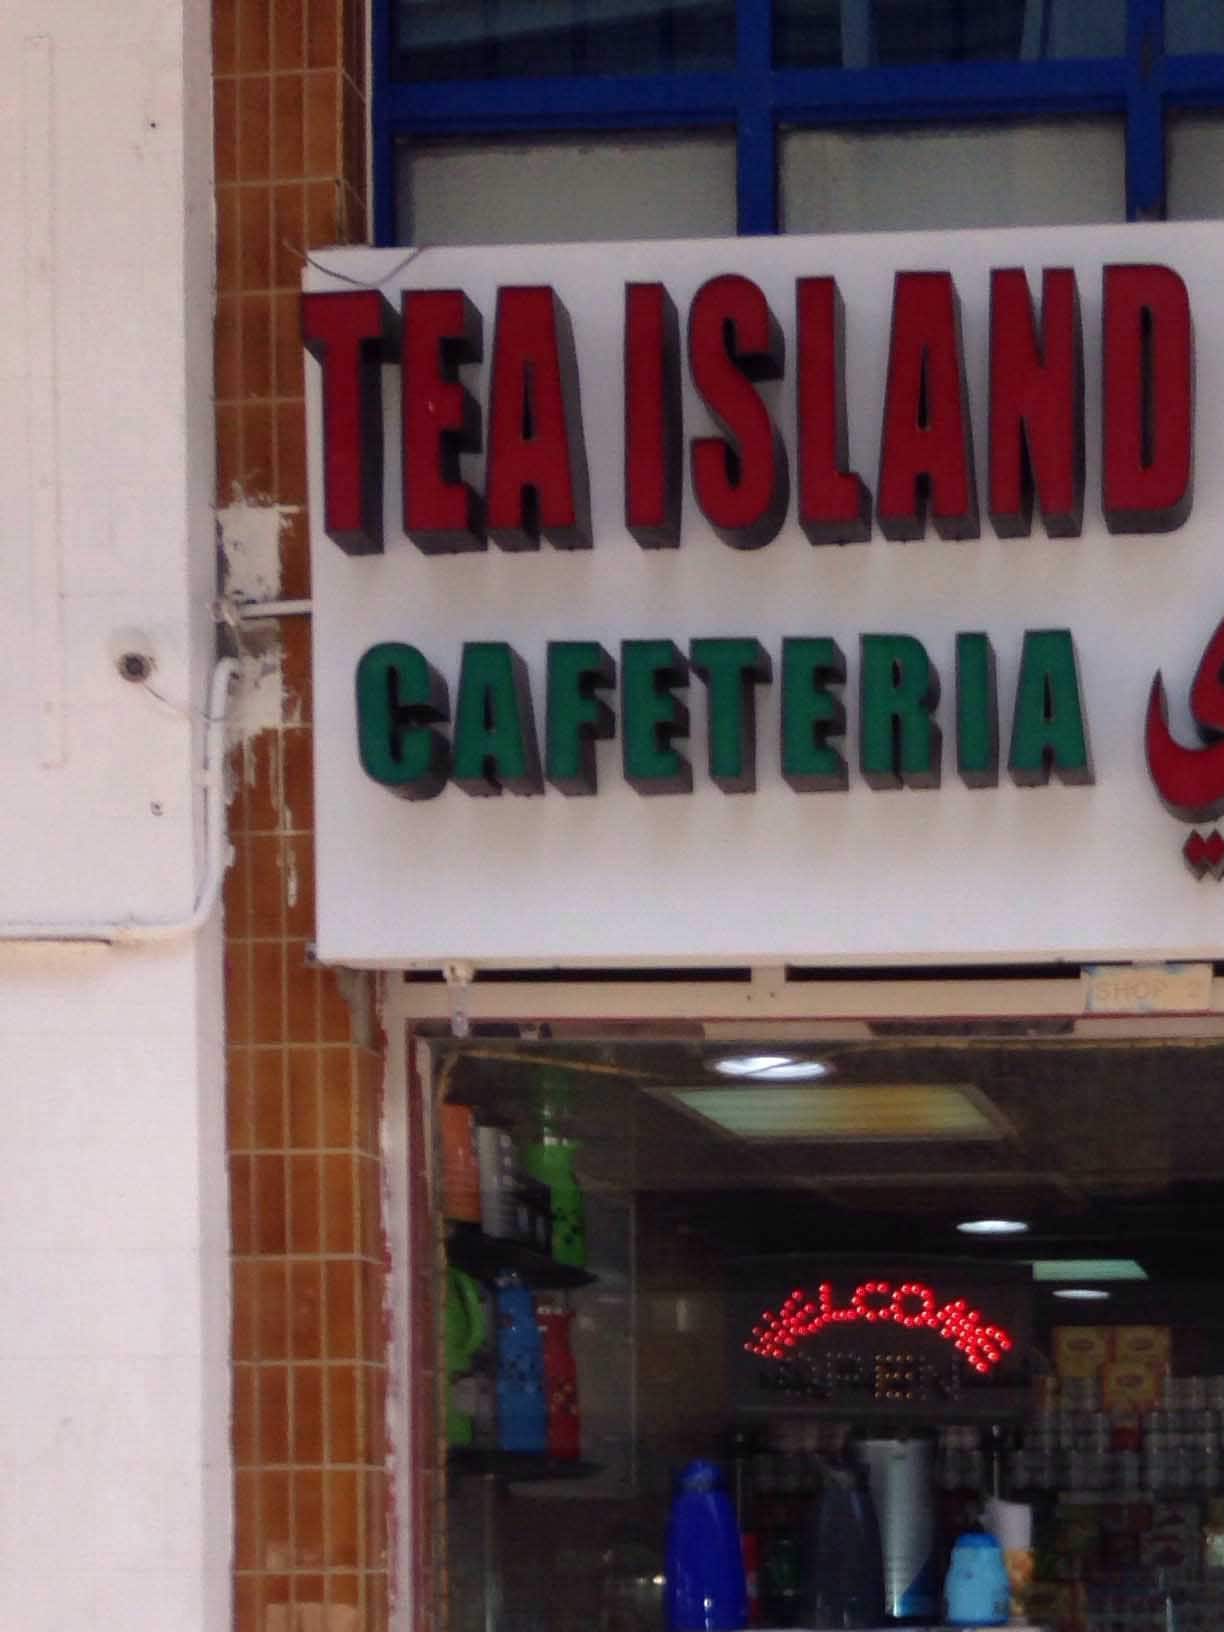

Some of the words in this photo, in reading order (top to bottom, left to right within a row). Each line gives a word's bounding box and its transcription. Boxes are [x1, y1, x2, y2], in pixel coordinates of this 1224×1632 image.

[302, 284, 594, 556] TEA
[624, 262, 1196, 550] ISLAND
[355, 627, 1096, 801] CAFETERIA
[743, 1279, 1014, 1374] WELCOME
